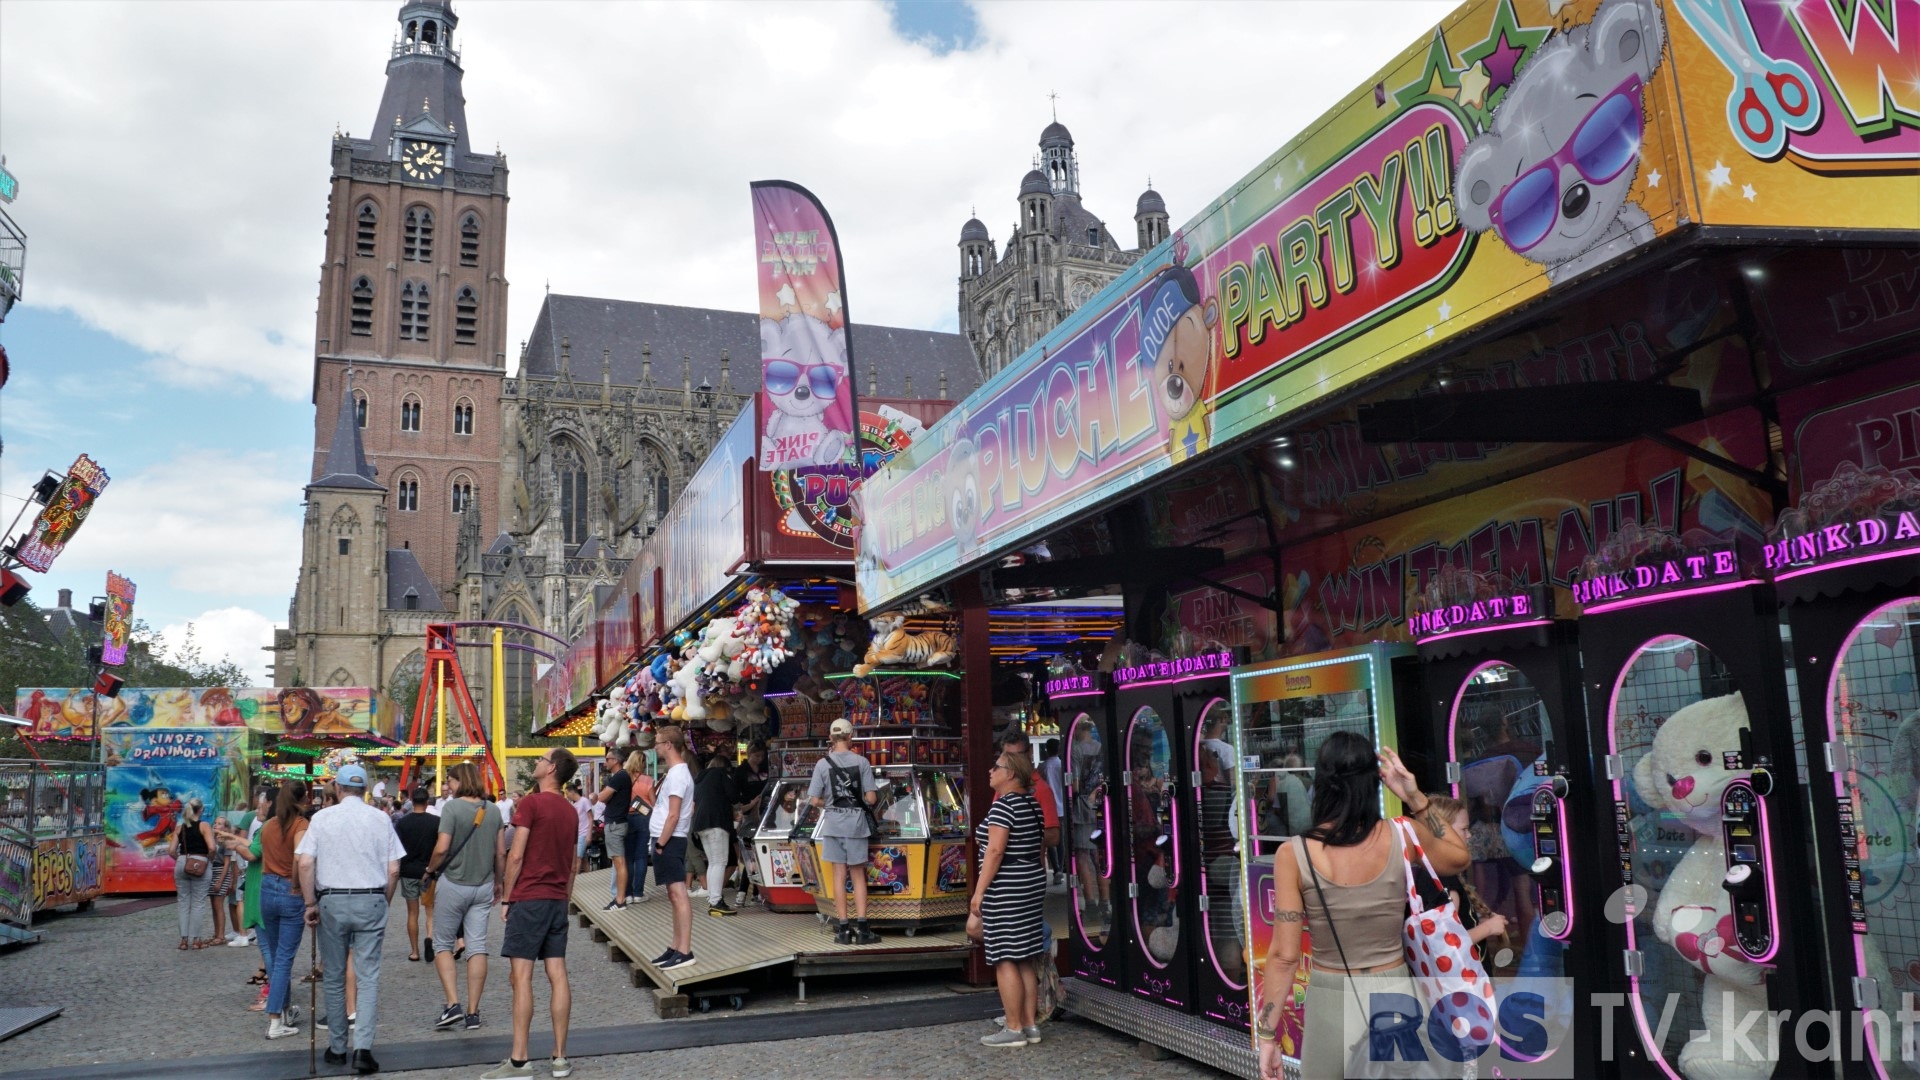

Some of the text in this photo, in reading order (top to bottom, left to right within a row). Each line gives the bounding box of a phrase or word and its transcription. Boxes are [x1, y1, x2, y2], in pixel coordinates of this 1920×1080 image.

[880, 122, 1458, 555] THE BIG PLUCHE PARTY!!
[1143, 290, 1181, 362] DUDE
[1319, 554, 1406, 637] WIN
[134, 745, 218, 760] DRAAIMOLEN
[148, 733, 204, 745] KINDER
